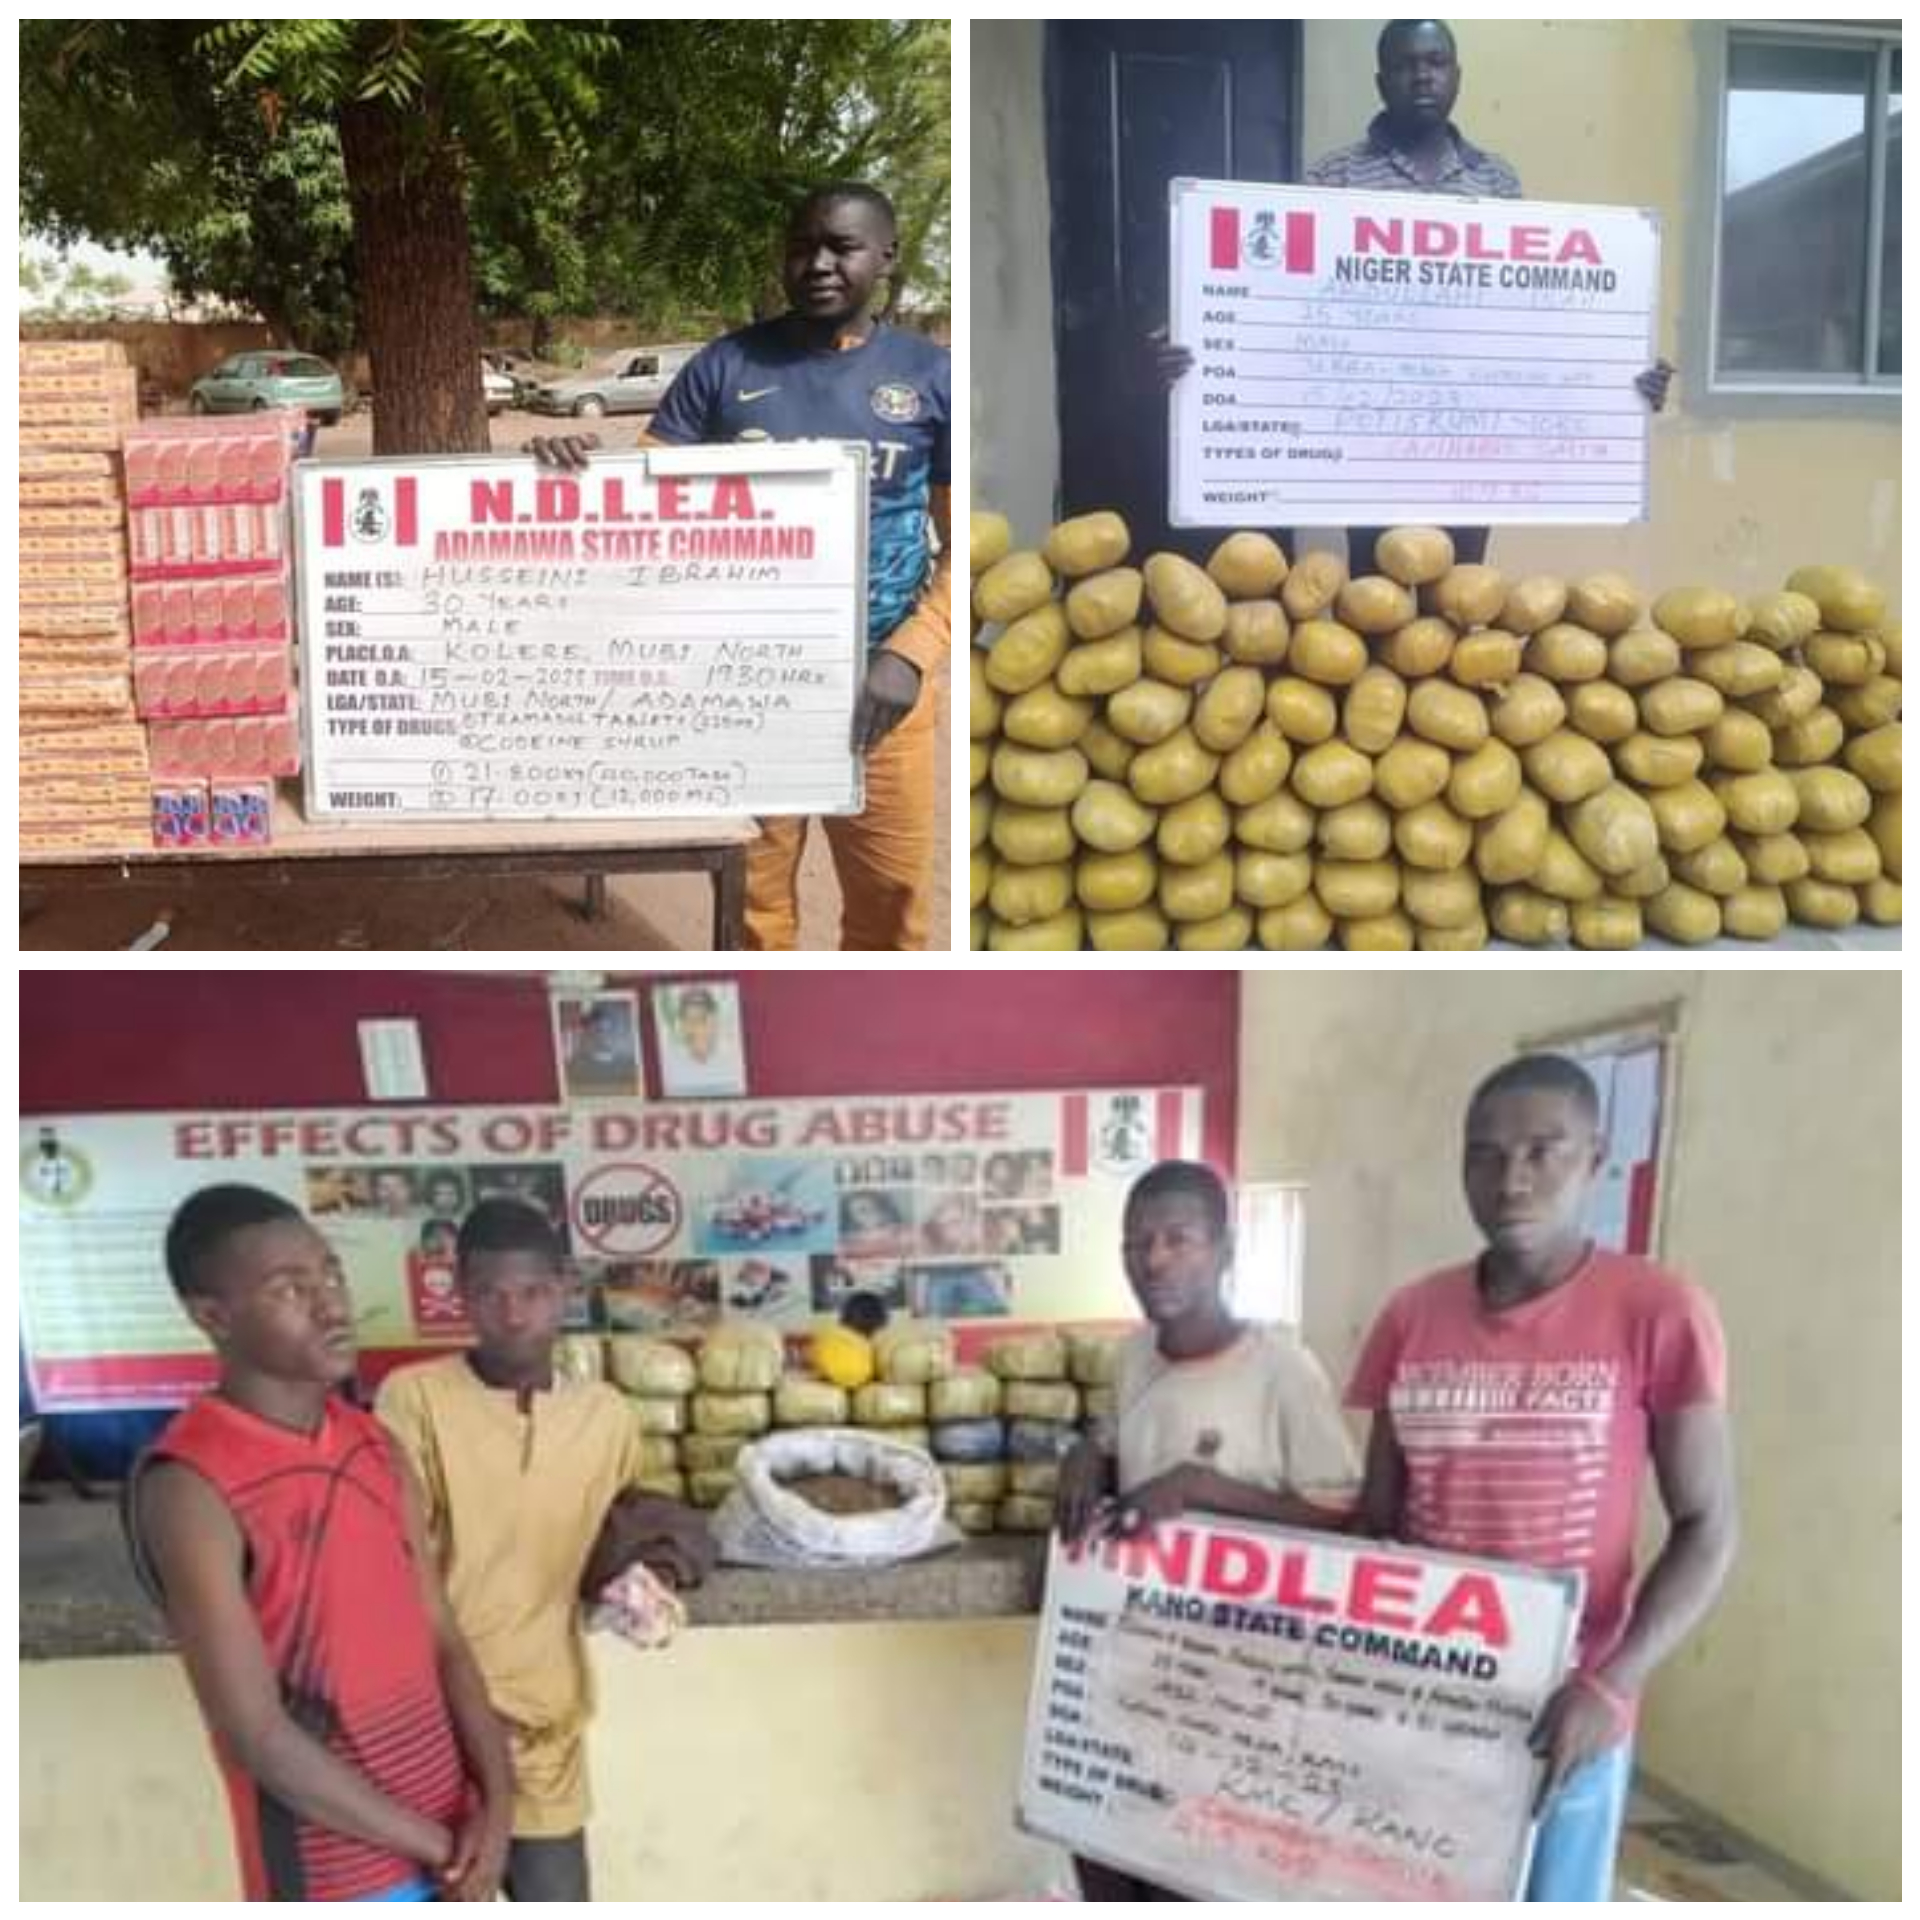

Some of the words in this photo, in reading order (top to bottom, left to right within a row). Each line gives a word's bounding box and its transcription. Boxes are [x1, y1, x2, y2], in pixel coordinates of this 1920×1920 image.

[1354, 216, 1603, 265] NDLEA
[1335, 257, 1412, 284] NIGER
[1418, 261, 1492, 288] STATE
[1500, 265, 1617, 293] COMMAND
[1202, 285, 1250, 298] NAME
[1202, 310, 1237, 323] AGE
[1202, 365, 1237, 378] POA
[1202, 393, 1238, 405] DOA
[1203, 446, 1257, 459] TYPES
[1261, 447, 1283, 459] OF
[470, 474, 775, 523] N.D.L.E.A.
[435, 531, 575, 561] ADAMAWA
[581, 529, 661, 561] STATE
[668, 526, 815, 560] COMMAND
[324, 572, 371, 588] NAME
[423, 565, 588, 587] HUSSEINI
[627, 562, 781, 585] IBRAHIM
[325, 597, 362, 613] AGE:
[425, 590, 464, 614] 30
[325, 621, 361, 638] SEX:
[443, 617, 522, 635] MALE
[608, 638, 691, 660] MUBI
[714, 641, 803, 661] NORTH
[327, 670, 366, 687] DATE
[432, 691, 511, 710] MUBI
[634, 692, 790, 709] ADAMAWA
[328, 719, 366, 736] TYPE
[372, 719, 392, 735] OF
[174, 1114, 461, 1160] EFFECTS
[480, 1112, 573, 1153] OF
[591, 1107, 779, 1151] DRUG
[800, 1102, 1015, 1147] ABUSE
[584, 1193, 671, 1225] DRUGS
[1122, 1528, 1511, 1650] NDLEA
[1126, 1585, 1205, 1622] KANO
[1212, 1600, 1306, 1641] STATE
[1314, 1622, 1498, 1681] COMMAND
